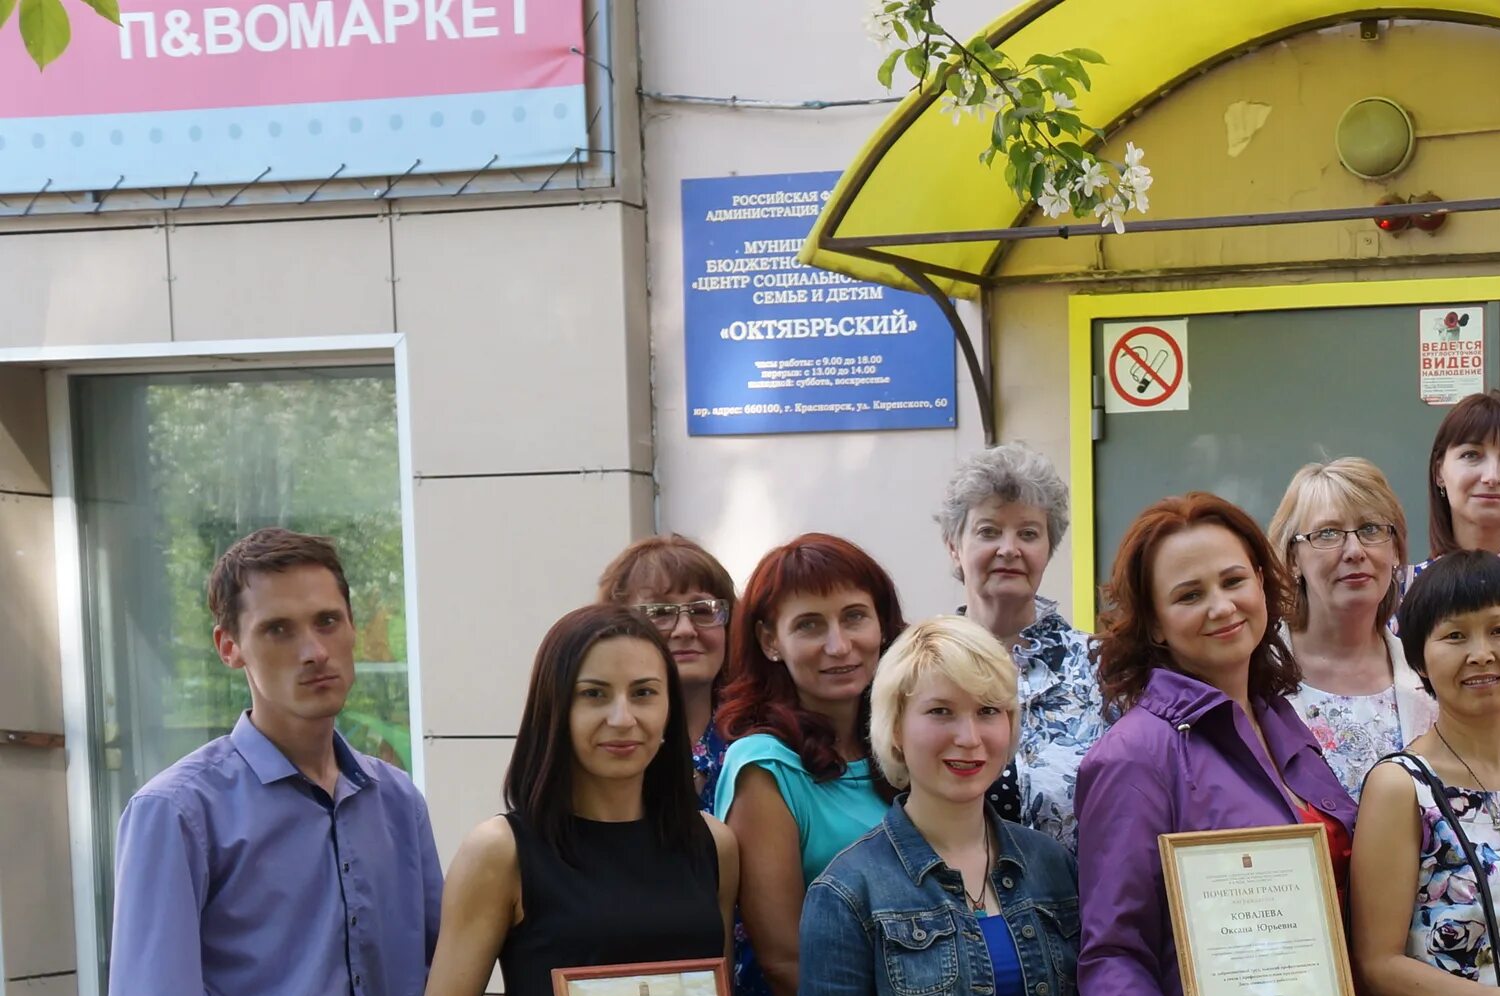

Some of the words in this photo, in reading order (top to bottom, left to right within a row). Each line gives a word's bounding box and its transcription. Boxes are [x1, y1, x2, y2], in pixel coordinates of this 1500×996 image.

[732, 190, 818, 206] РОССИЙСКАЯ
[706, 205, 818, 221] АДМИНИСТРАЦИЯ
[706, 256, 812, 273] БЮДЖЕТНО
[692, 277, 750, 290] «ЦЕНТР
[753, 272, 863, 288] СОЦИАЛЬНО
[752, 291, 808, 305] СЕМЬЕ
[812, 289, 823, 302] И
[825, 286, 884, 303] ДЕТЯМ
[720, 309, 918, 341] «ОКТЯБРЬСКИЙ»
[1422, 341, 1482, 351] ВЕДЕТСЯ
[822, 356, 842, 366] 9.00
[1423, 356, 1481, 369] ВИДЕО
[812, 367, 836, 376] 13.00
[851, 365, 876, 374] 14.00
[1422, 369, 1482, 377] НАБЛЮДЕНИЕ
[934, 398, 948, 407] 60
[1203, 887, 1254, 899] ПОЧЕТНАЯ
[1256, 884, 1300, 894] ГРАМОТА
[1231, 909, 1283, 920] КОВАЛЕВА
[1220, 926, 1253, 935] Оксана
[1257, 922, 1297, 933] Юрьевна
